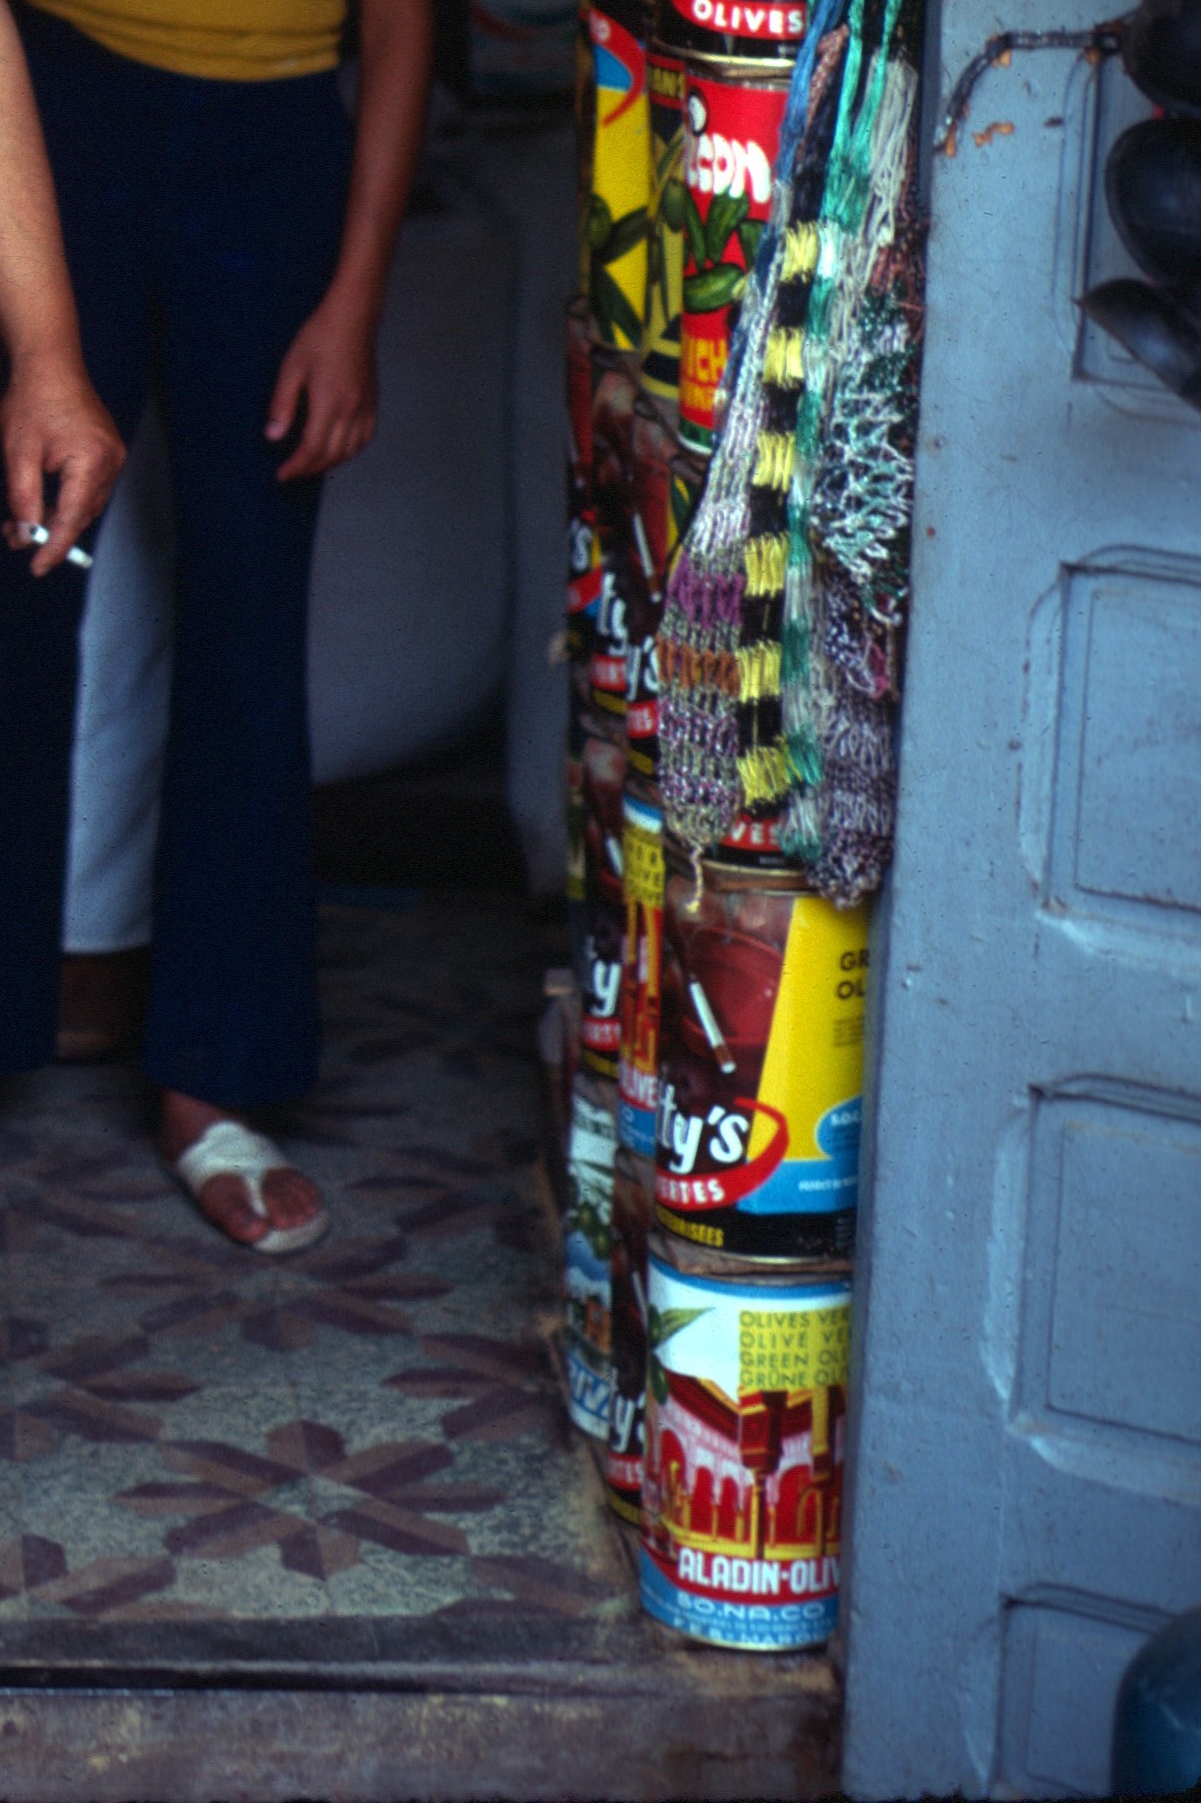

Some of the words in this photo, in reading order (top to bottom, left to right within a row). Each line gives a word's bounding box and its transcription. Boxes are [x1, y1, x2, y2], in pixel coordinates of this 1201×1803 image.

[740, 1311, 810, 1328] OLIVES
[740, 1331, 807, 1349] OLIVE
[740, 1351, 809, 1369] GREEN
